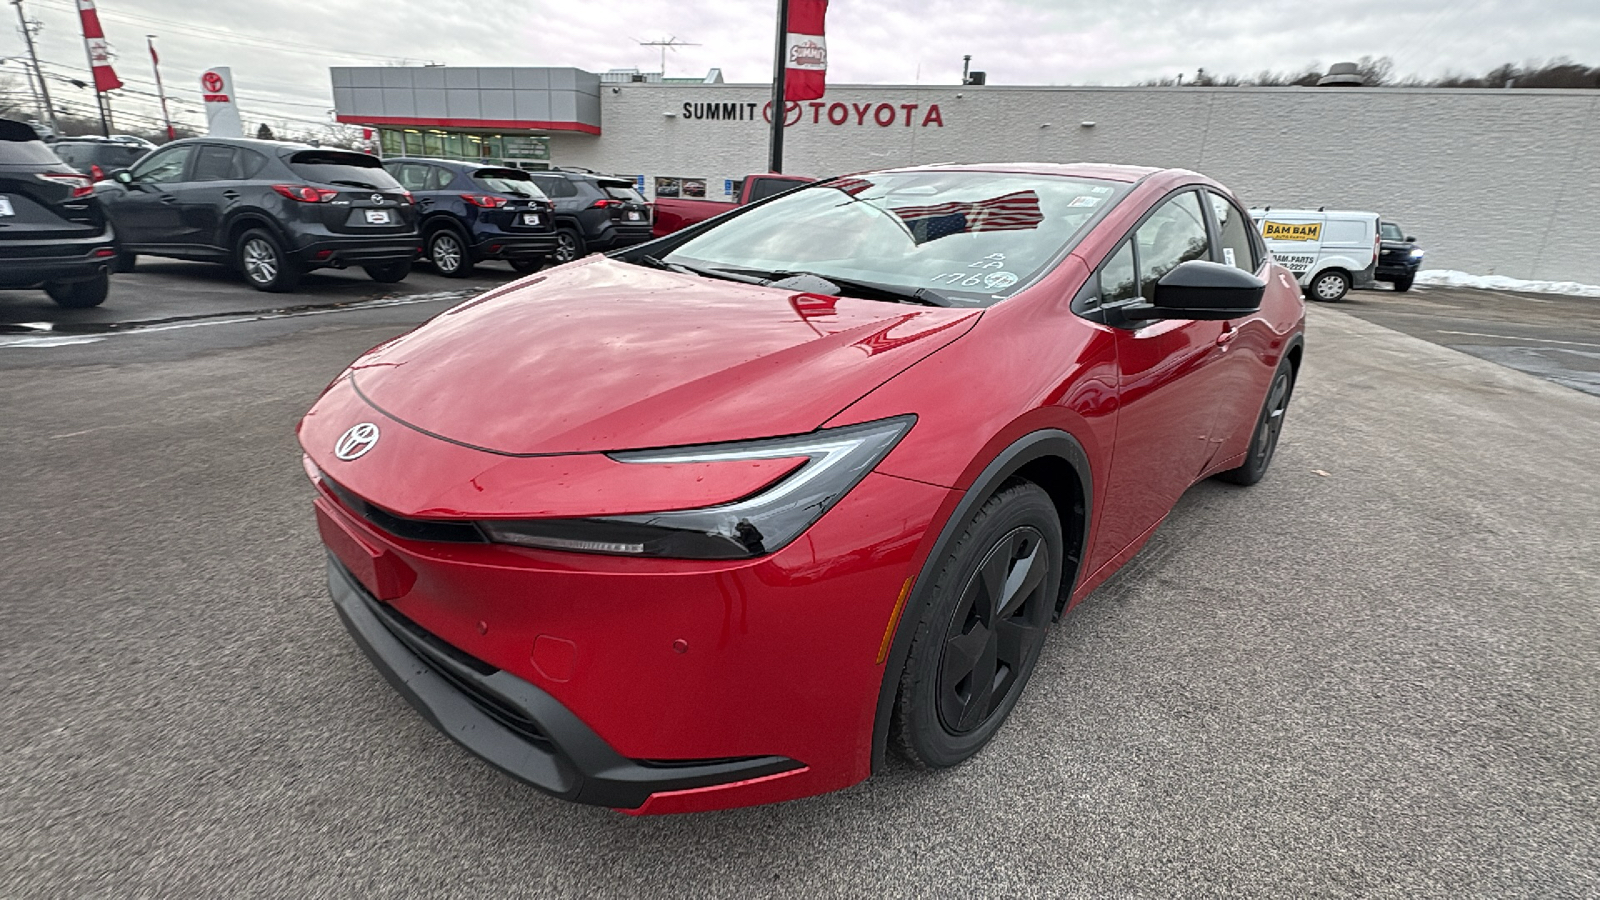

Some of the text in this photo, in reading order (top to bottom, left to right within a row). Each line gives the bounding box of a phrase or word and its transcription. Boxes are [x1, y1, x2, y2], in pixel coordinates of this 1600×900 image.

[683, 102, 944, 127] SUMMIT TOYOTA
[1267, 225, 1317, 235] BAM BAM
